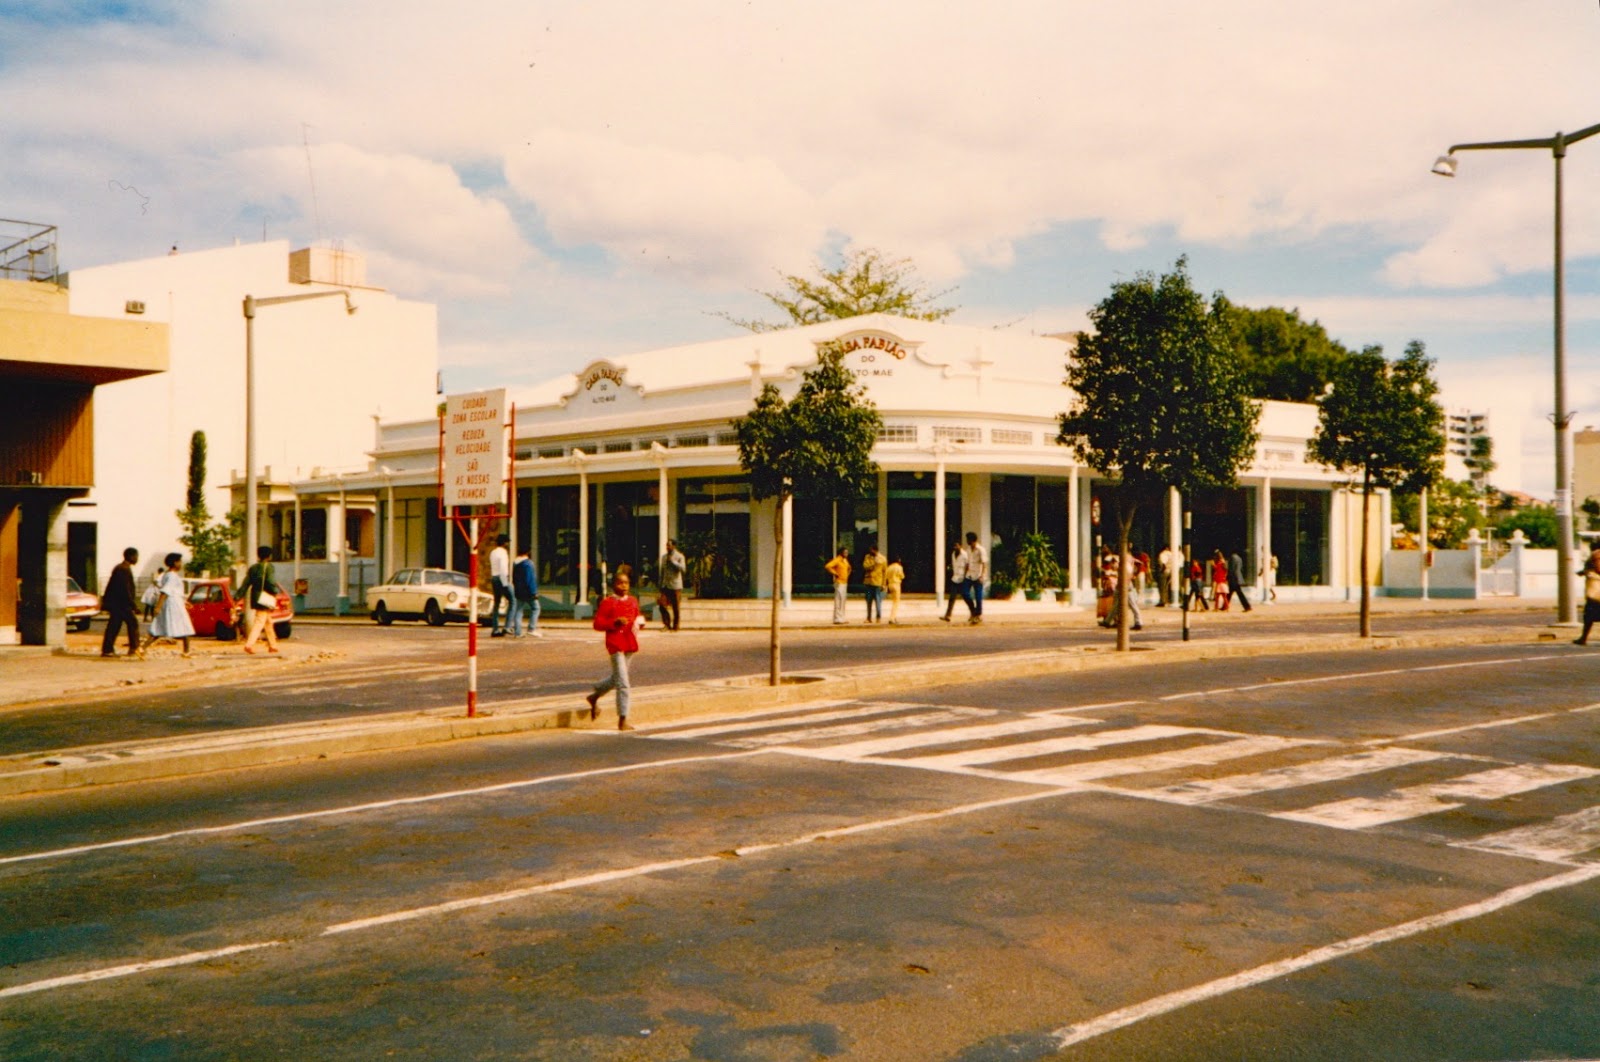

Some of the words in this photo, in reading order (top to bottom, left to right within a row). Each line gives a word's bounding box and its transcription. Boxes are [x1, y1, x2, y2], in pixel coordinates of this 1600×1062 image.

[861, 355, 875, 363] DO
[462, 397, 487, 409] CUIDADO
[452, 413, 467, 424] ZONA
[469, 409, 497, 422] ESCOLAR
[462, 429, 485, 440] REDUZA
[455, 441, 491, 454] VELOCIDADE
[467, 474, 490, 485] NOSSAS
